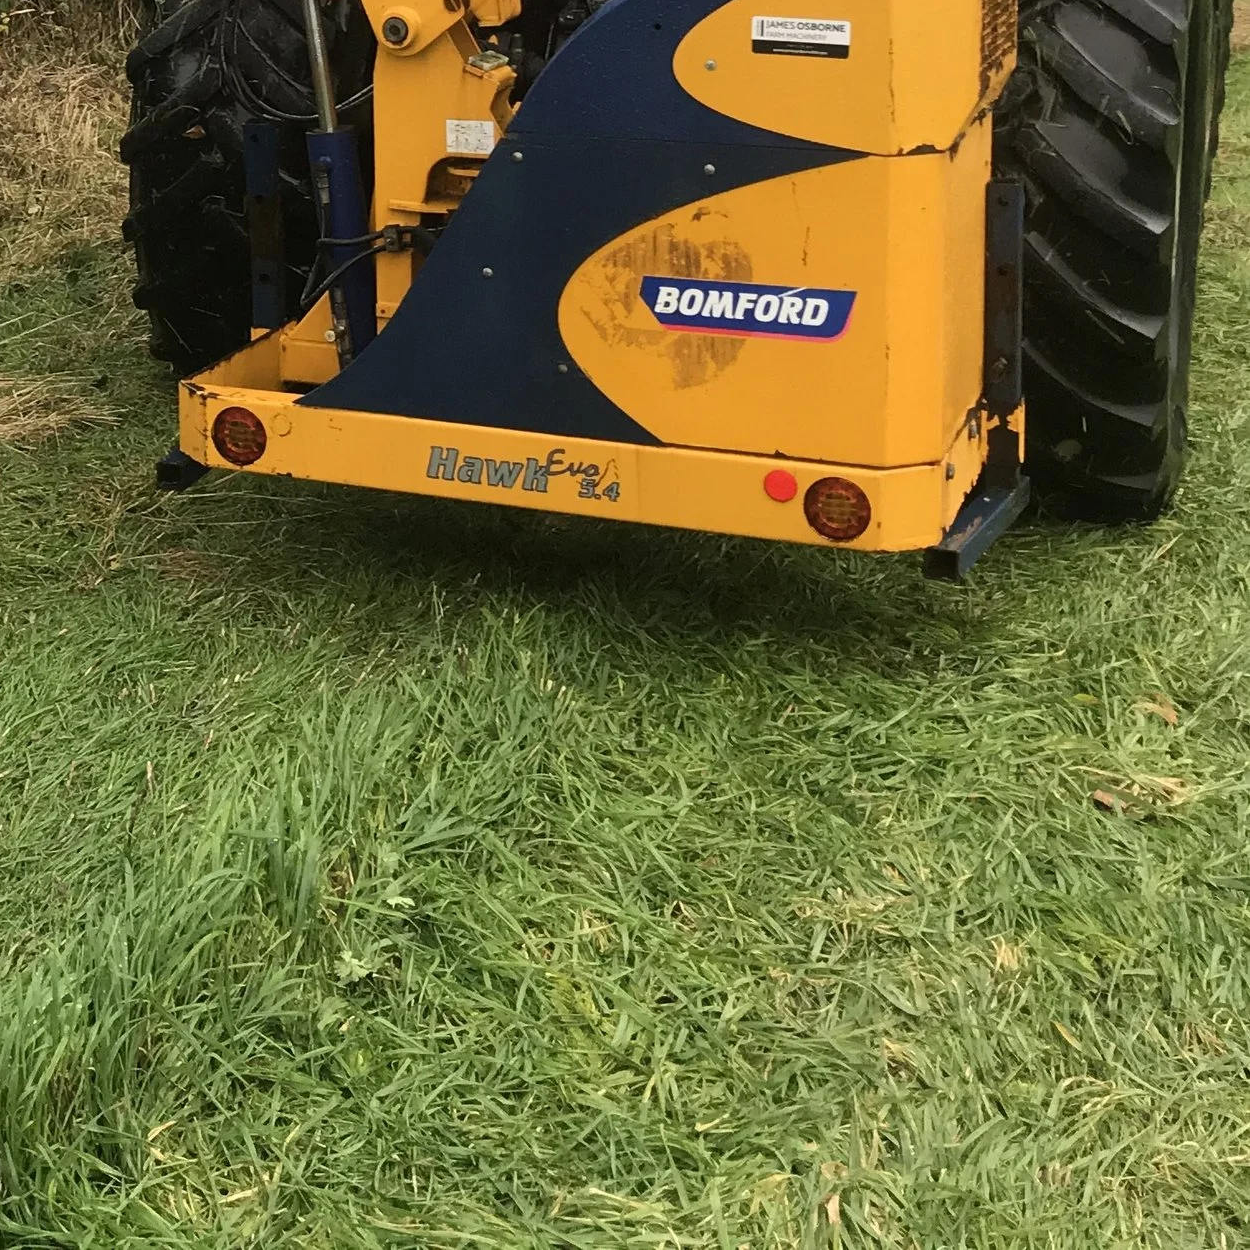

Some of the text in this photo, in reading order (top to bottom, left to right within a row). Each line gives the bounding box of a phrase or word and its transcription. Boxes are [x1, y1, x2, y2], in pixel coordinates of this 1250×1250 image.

[766, 20, 796, 30] JAMES
[796, 22, 846, 33] OSBORNE
[654, 286, 829, 327] BOMFORD
[426, 446, 549, 493] Hawk
